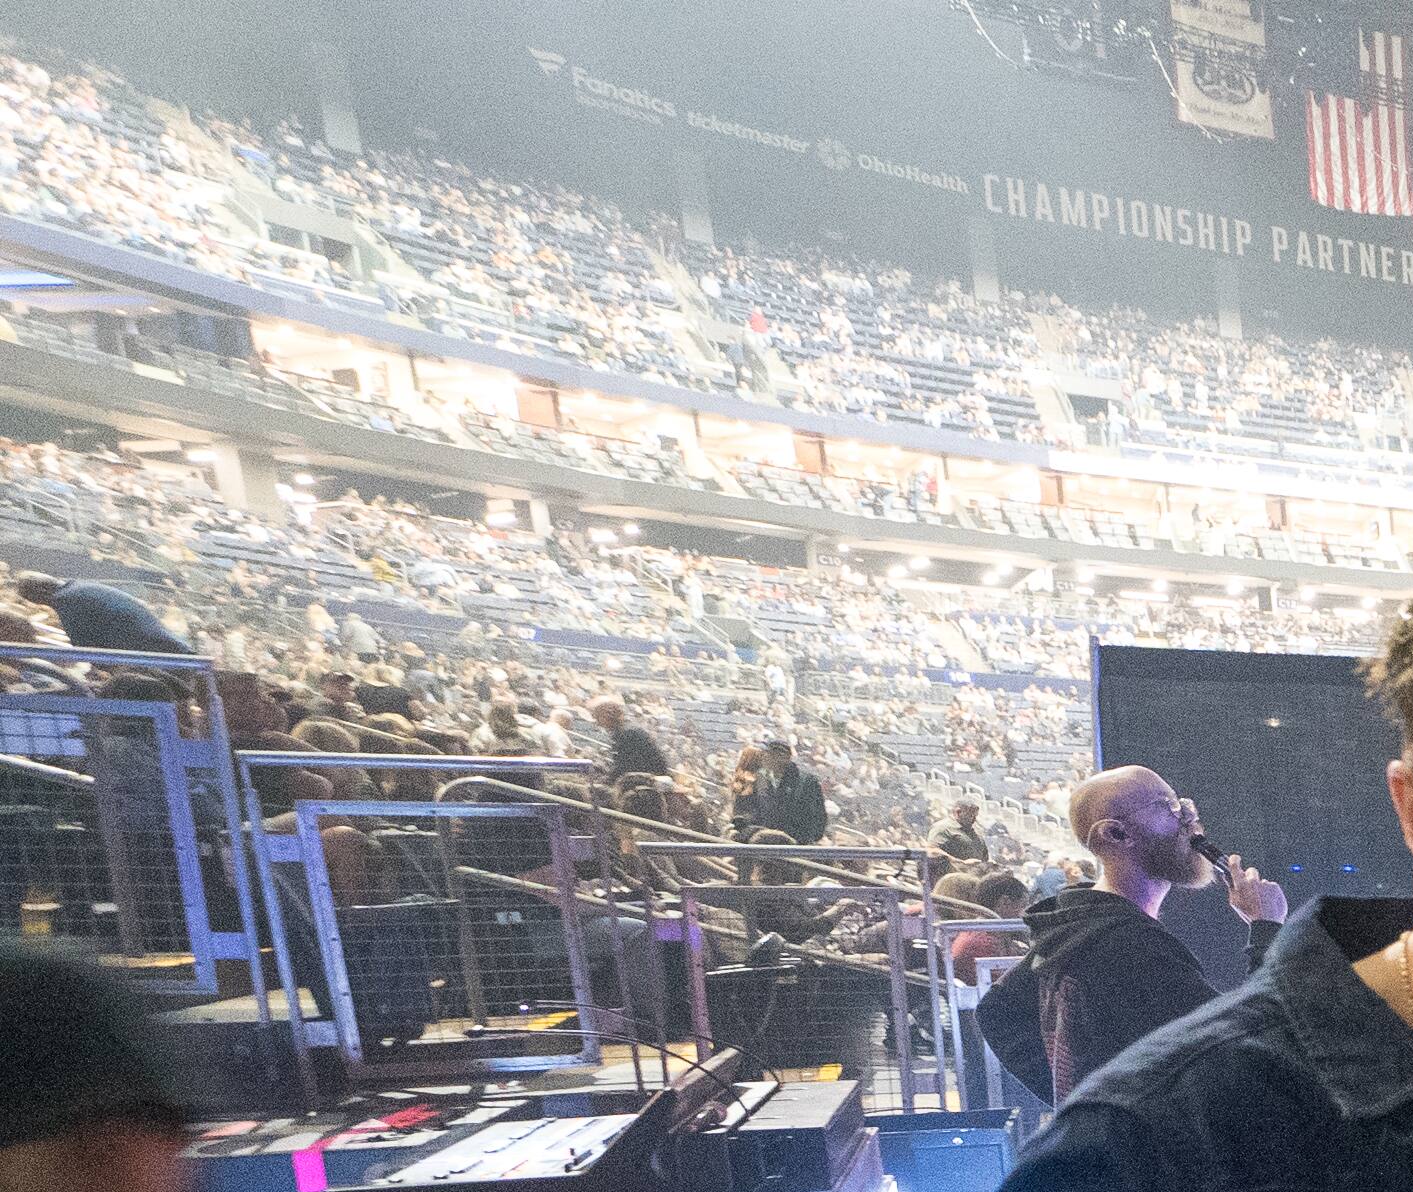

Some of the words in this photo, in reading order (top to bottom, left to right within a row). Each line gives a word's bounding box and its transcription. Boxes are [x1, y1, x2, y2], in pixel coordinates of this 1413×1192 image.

[572, 65, 676, 117] Fanatics
[688, 111, 811, 154] ticketmaster
[857, 153, 969, 195] OhioHealth
[983, 173, 1252, 257] CHAMPIONSHIP
